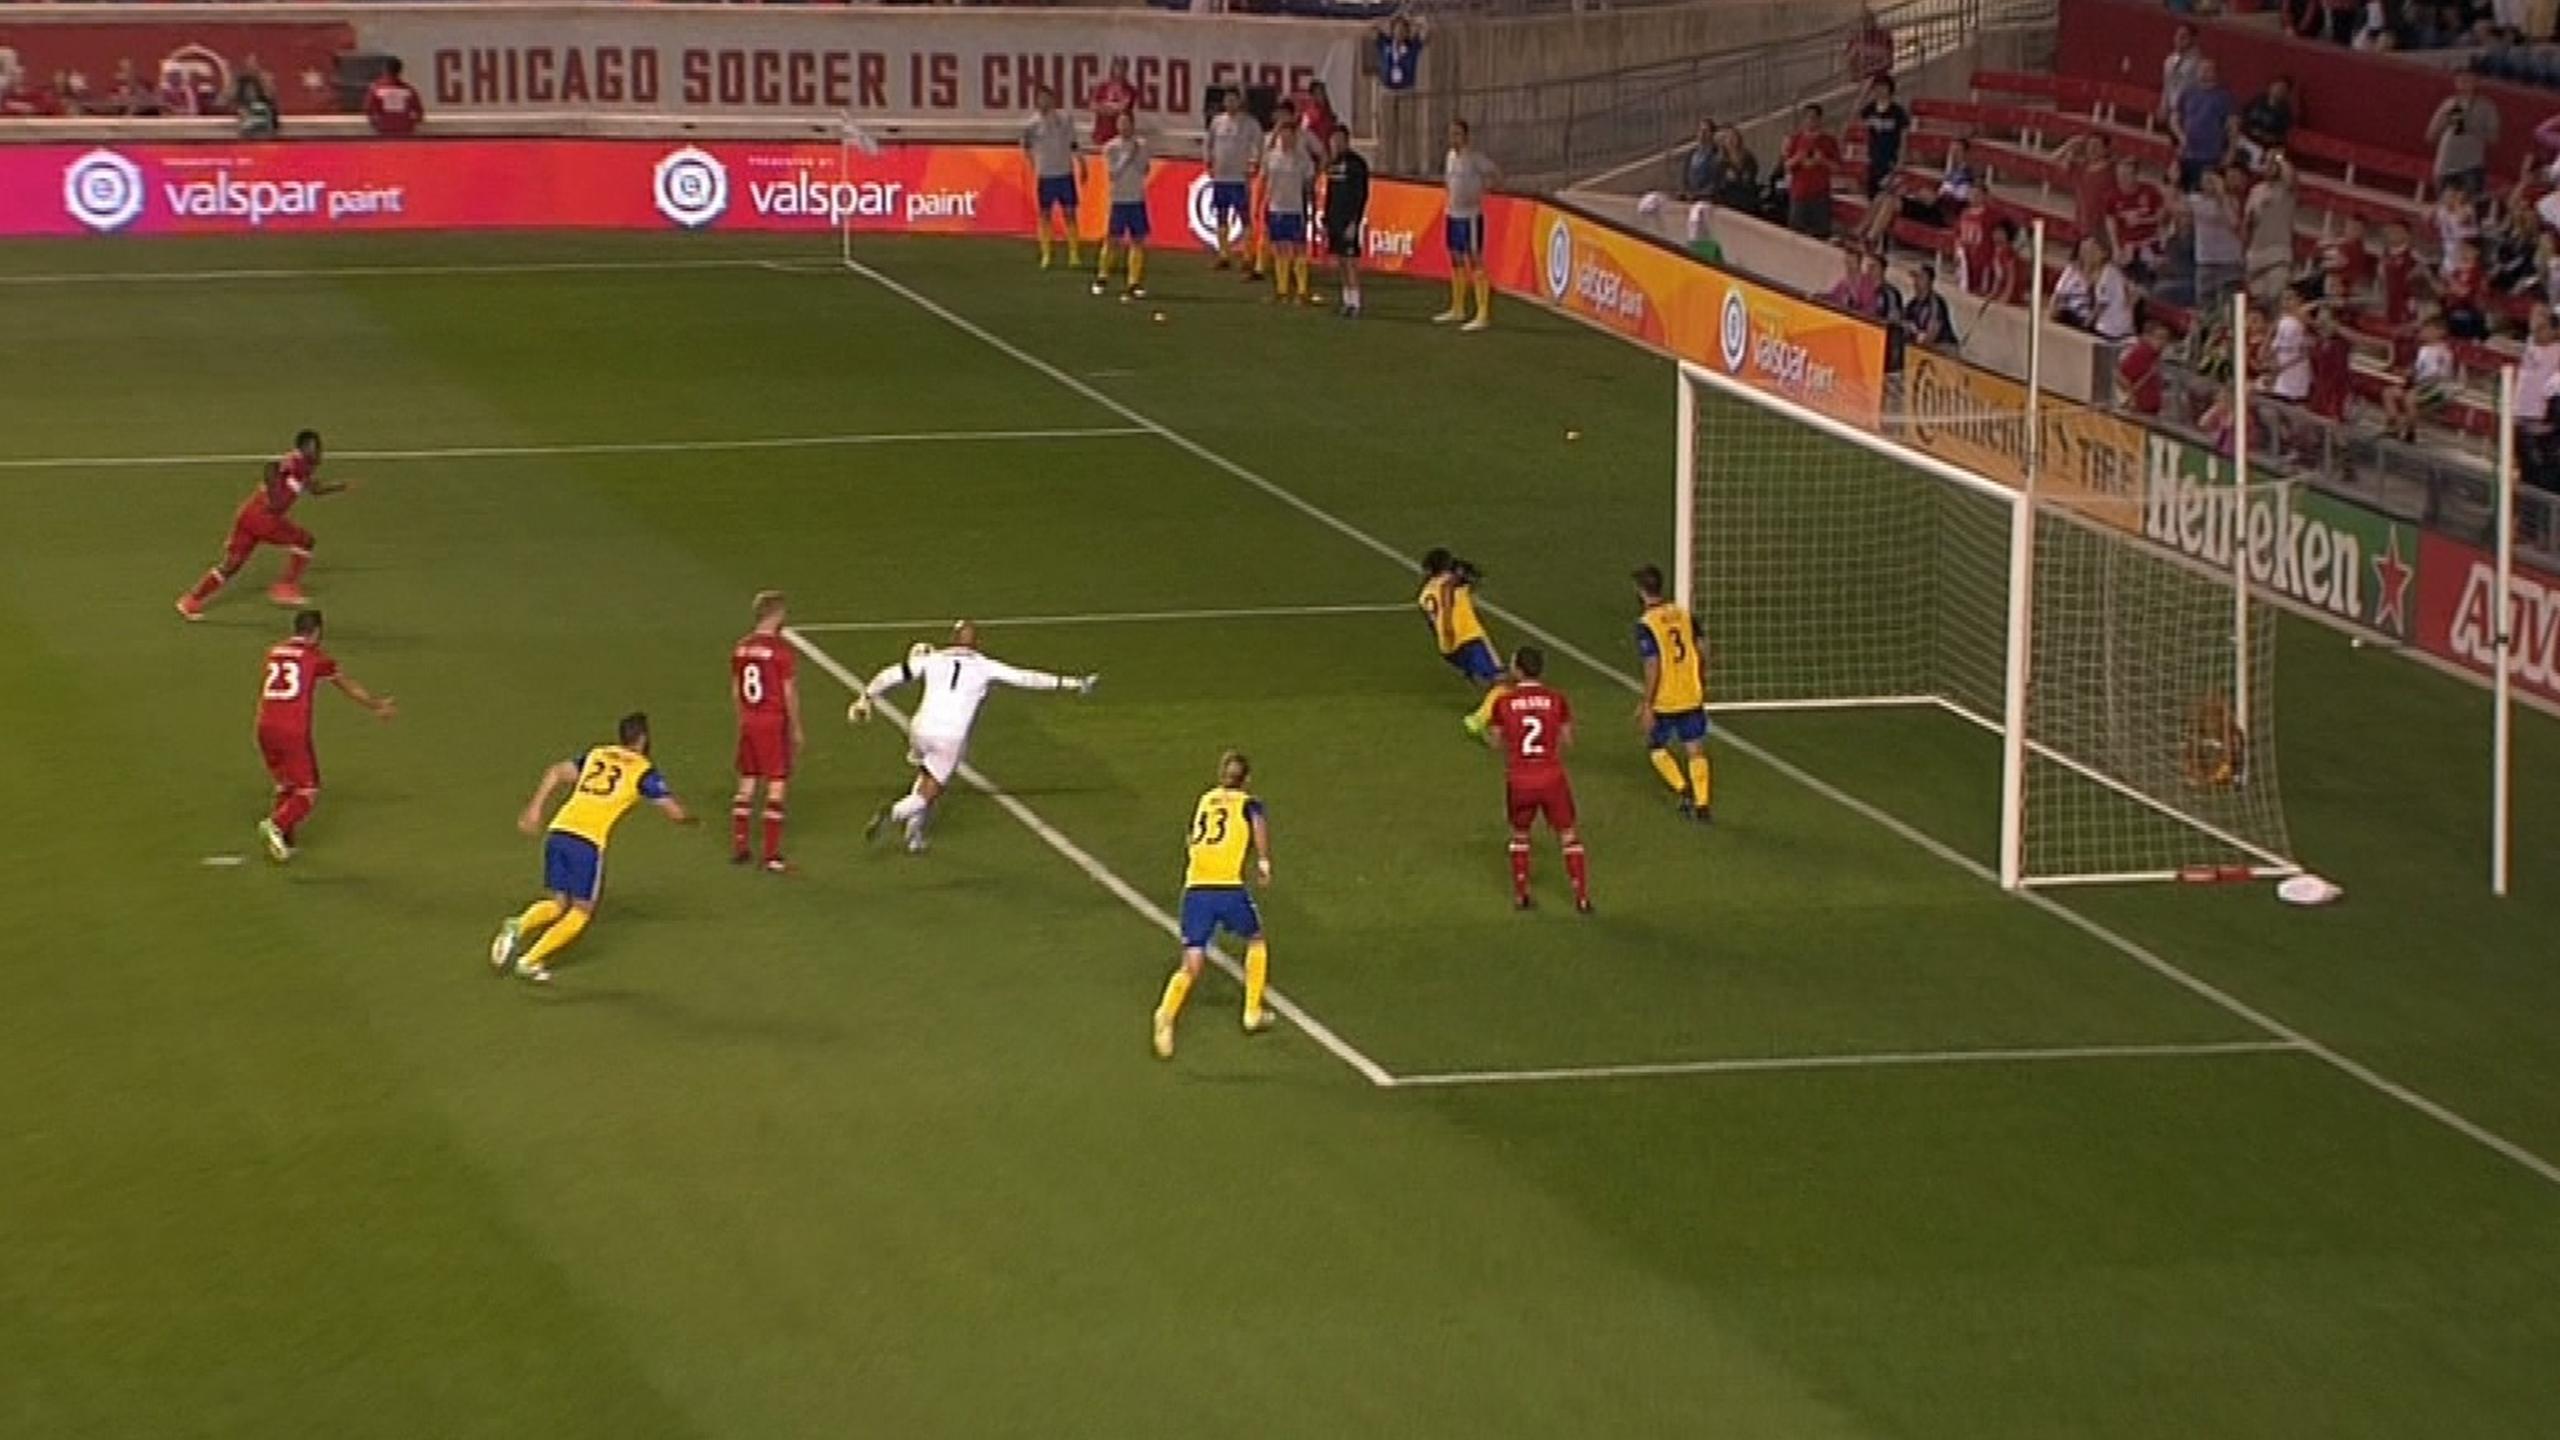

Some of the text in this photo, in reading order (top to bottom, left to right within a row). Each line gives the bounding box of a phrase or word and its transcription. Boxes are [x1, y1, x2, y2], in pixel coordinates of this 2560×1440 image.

[435, 47, 659, 103] CHICAGO
[681, 48, 888, 107] SOCCER
[910, 52, 958, 109] IS
[982, 55, 1191, 114] CHICGO
[163, 170, 405, 225] valspar paint
[749, 168, 976, 225] valspar paint
[1368, 223, 1414, 258] paint
[2076, 436, 2134, 494] TIRE
[2147, 434, 2361, 618] Heineken
[1668, 627, 1686, 663] 3
[263, 662, 300, 700] 23
[743, 663, 763, 703] 8
[950, 659, 961, 691] 1
[1521, 715, 1545, 757] 2
[577, 761, 622, 796] 23
